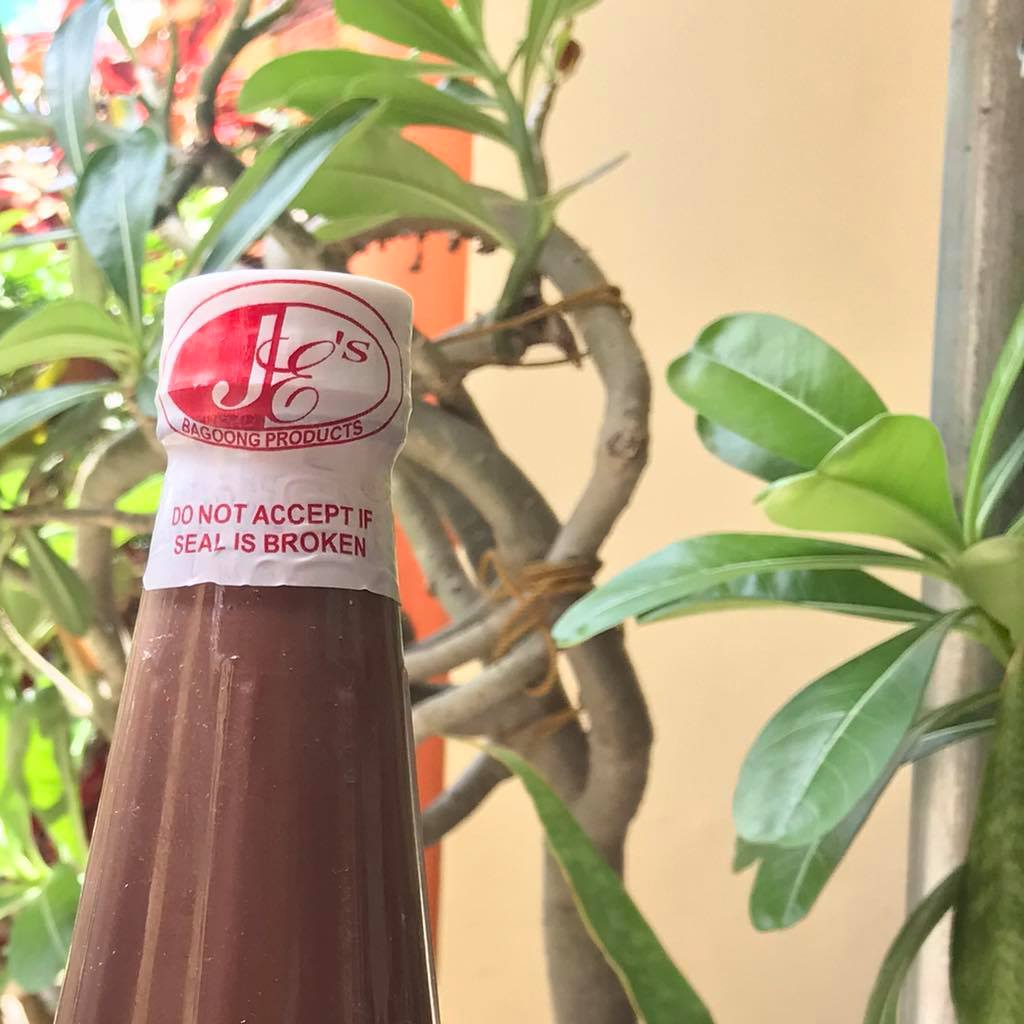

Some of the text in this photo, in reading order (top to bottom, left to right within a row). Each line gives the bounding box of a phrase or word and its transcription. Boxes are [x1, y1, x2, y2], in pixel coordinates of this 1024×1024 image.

[181, 417, 364, 447] BAGOONG PRODUCTS
[171, 504, 373, 530] DO NOT ACCEPT IF
[174, 532, 367, 558] SEAL IS BROKEN
